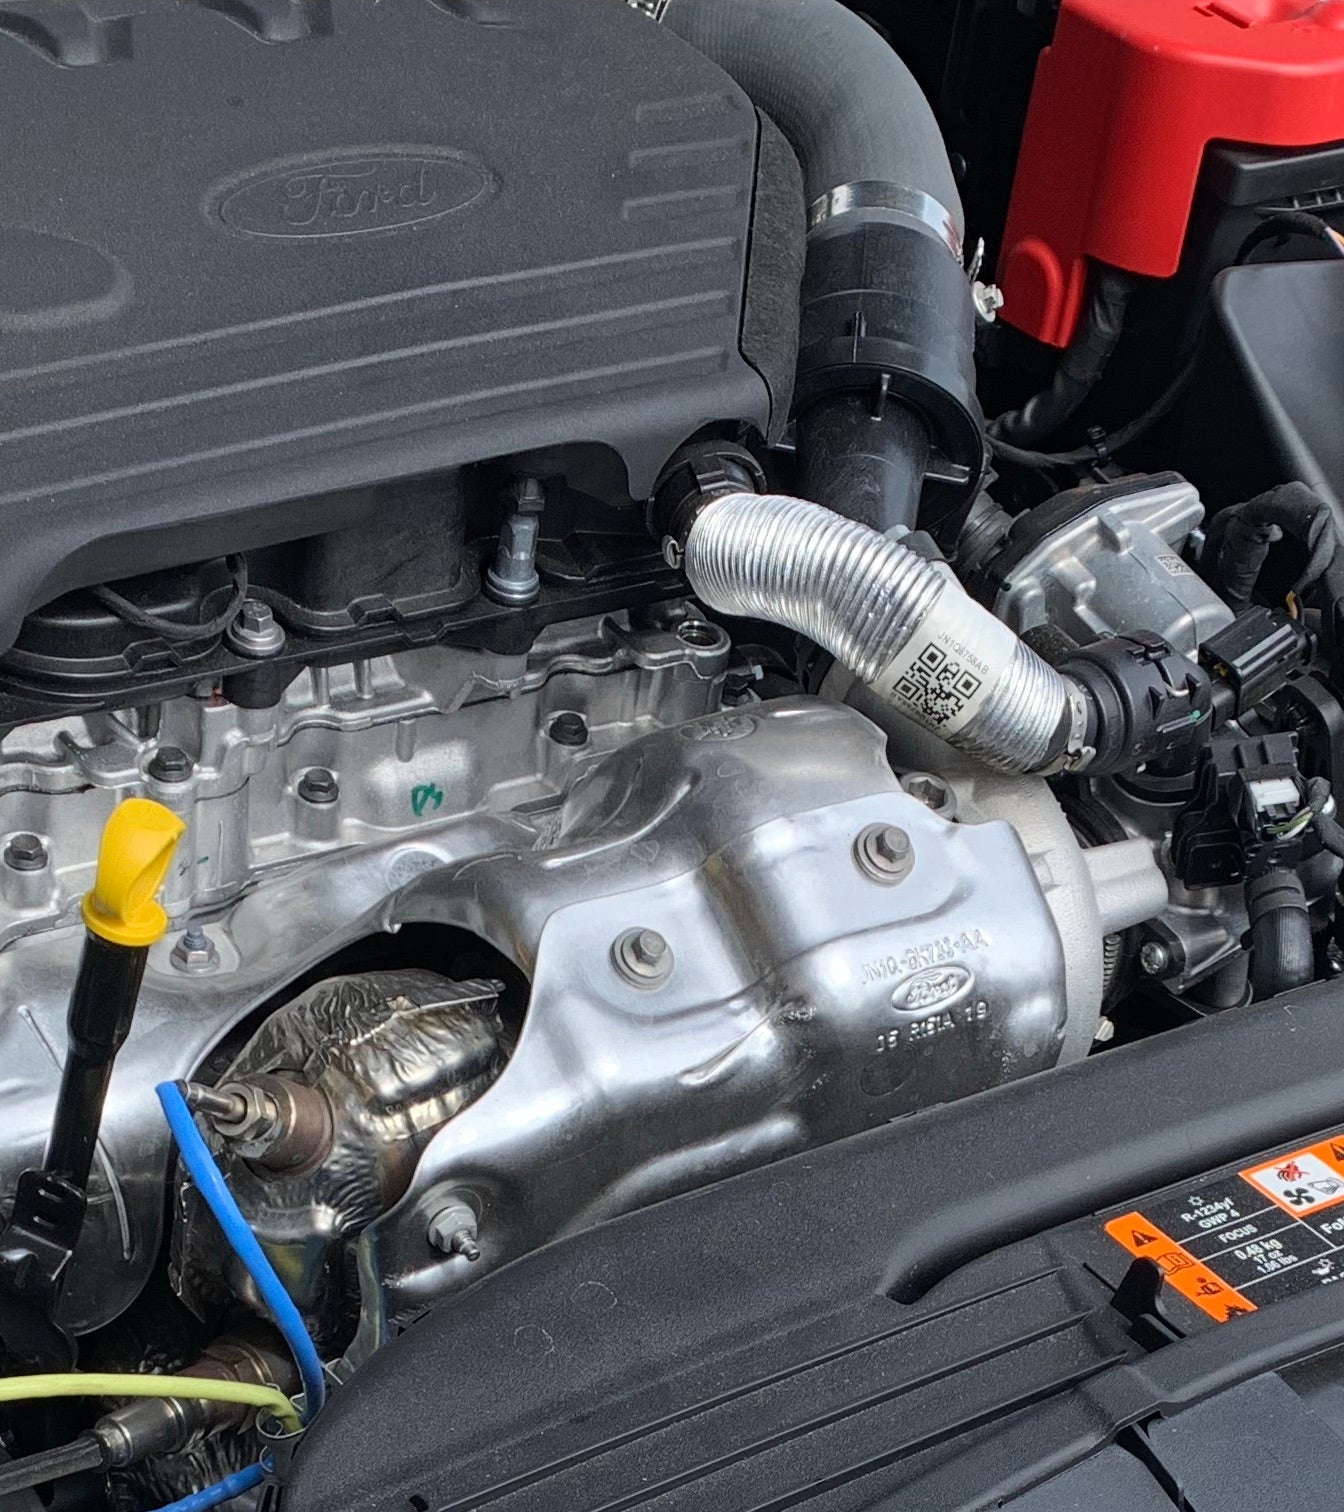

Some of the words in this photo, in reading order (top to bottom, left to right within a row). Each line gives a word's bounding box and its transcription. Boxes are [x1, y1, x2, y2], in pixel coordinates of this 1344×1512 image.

[1181, 1196, 1234, 1224] R-1234yf
[1198, 1212, 1229, 1230] GWP
[1218, 1224, 1258, 1243] FOCUS
[1261, 1237, 1283, 1254] kg
[1276, 1253, 1298, 1268] lbs
